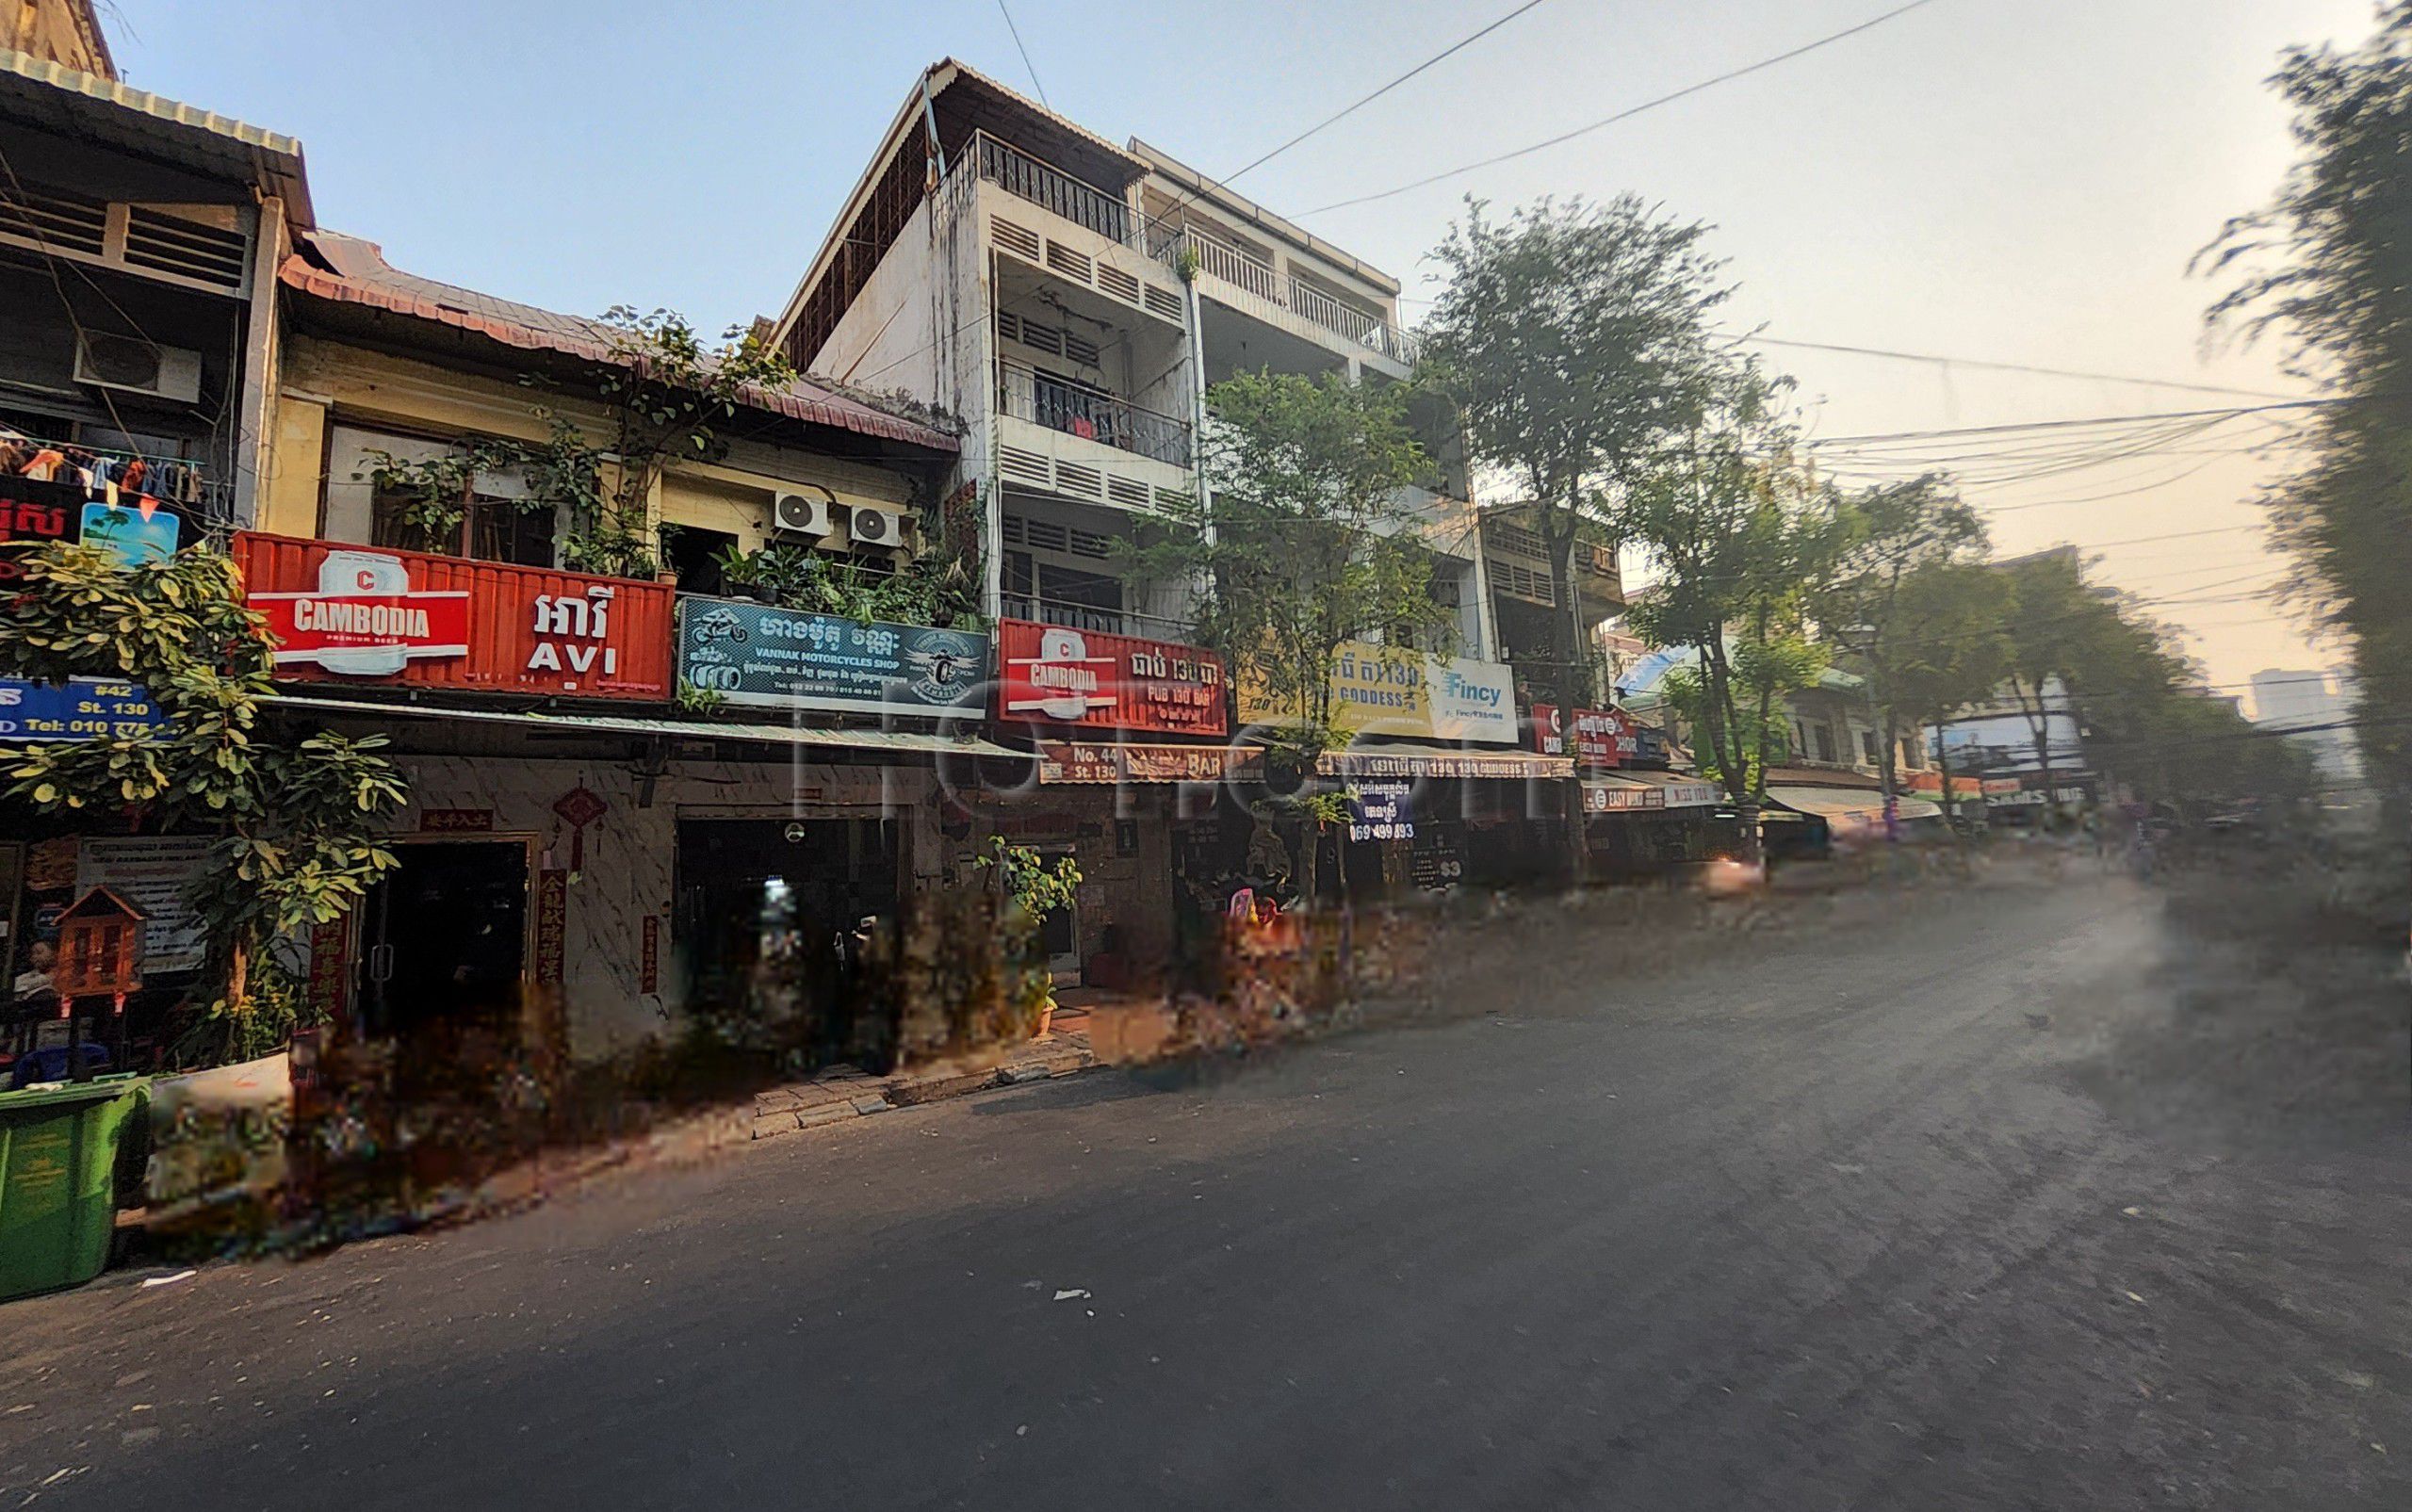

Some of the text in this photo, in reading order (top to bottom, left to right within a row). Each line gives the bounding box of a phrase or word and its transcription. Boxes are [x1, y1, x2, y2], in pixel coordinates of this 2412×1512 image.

[294, 598, 430, 639] CAMBODIA
[528, 642, 616, 675] AVI
[755, 647, 800, 660] VANNAK
[801, 651, 872, 667] MOTORCYCLES
[873, 660, 900, 670] SHOP
[1031, 663, 1098, 691] CAMBODIA
[94, 685, 133, 697] #42
[1149, 686, 1168, 702] PUB
[1341, 687, 1404, 707] GODDESS
[1442, 672, 1501, 707] Fincy
[77, 701, 149, 716] St. 130
[24, 719, 65, 733] Tel:
[70, 721, 108, 734] 010
[1074, 747, 1098, 762] No.
[1100, 748, 1118, 763] 44
[1074, 765, 1091, 777] St.
[1096, 765, 1116, 778] 130
[1187, 754, 1221, 777] BAR
